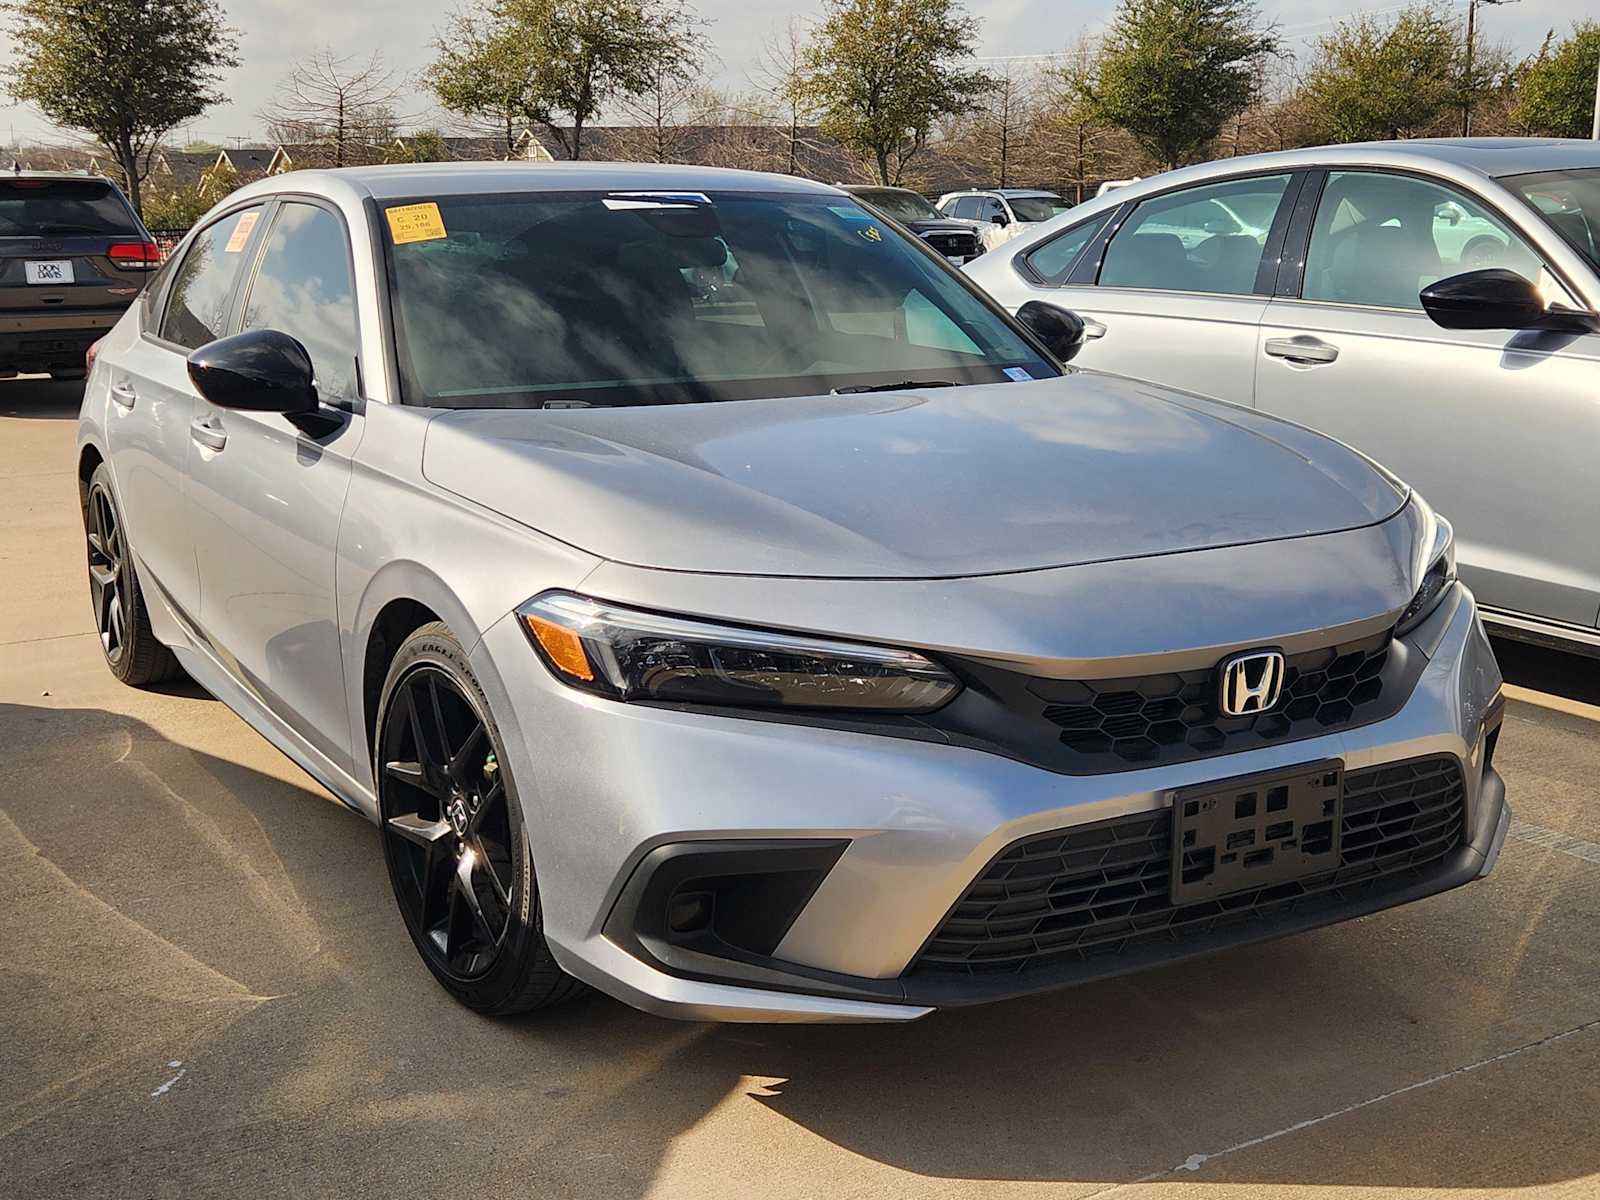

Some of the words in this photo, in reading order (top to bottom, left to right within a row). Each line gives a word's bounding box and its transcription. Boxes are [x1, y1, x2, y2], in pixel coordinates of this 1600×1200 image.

[38, 264, 60, 272] DON
[38, 271, 62, 279] DAVIS
[421, 644, 456, 661] EAGLE
